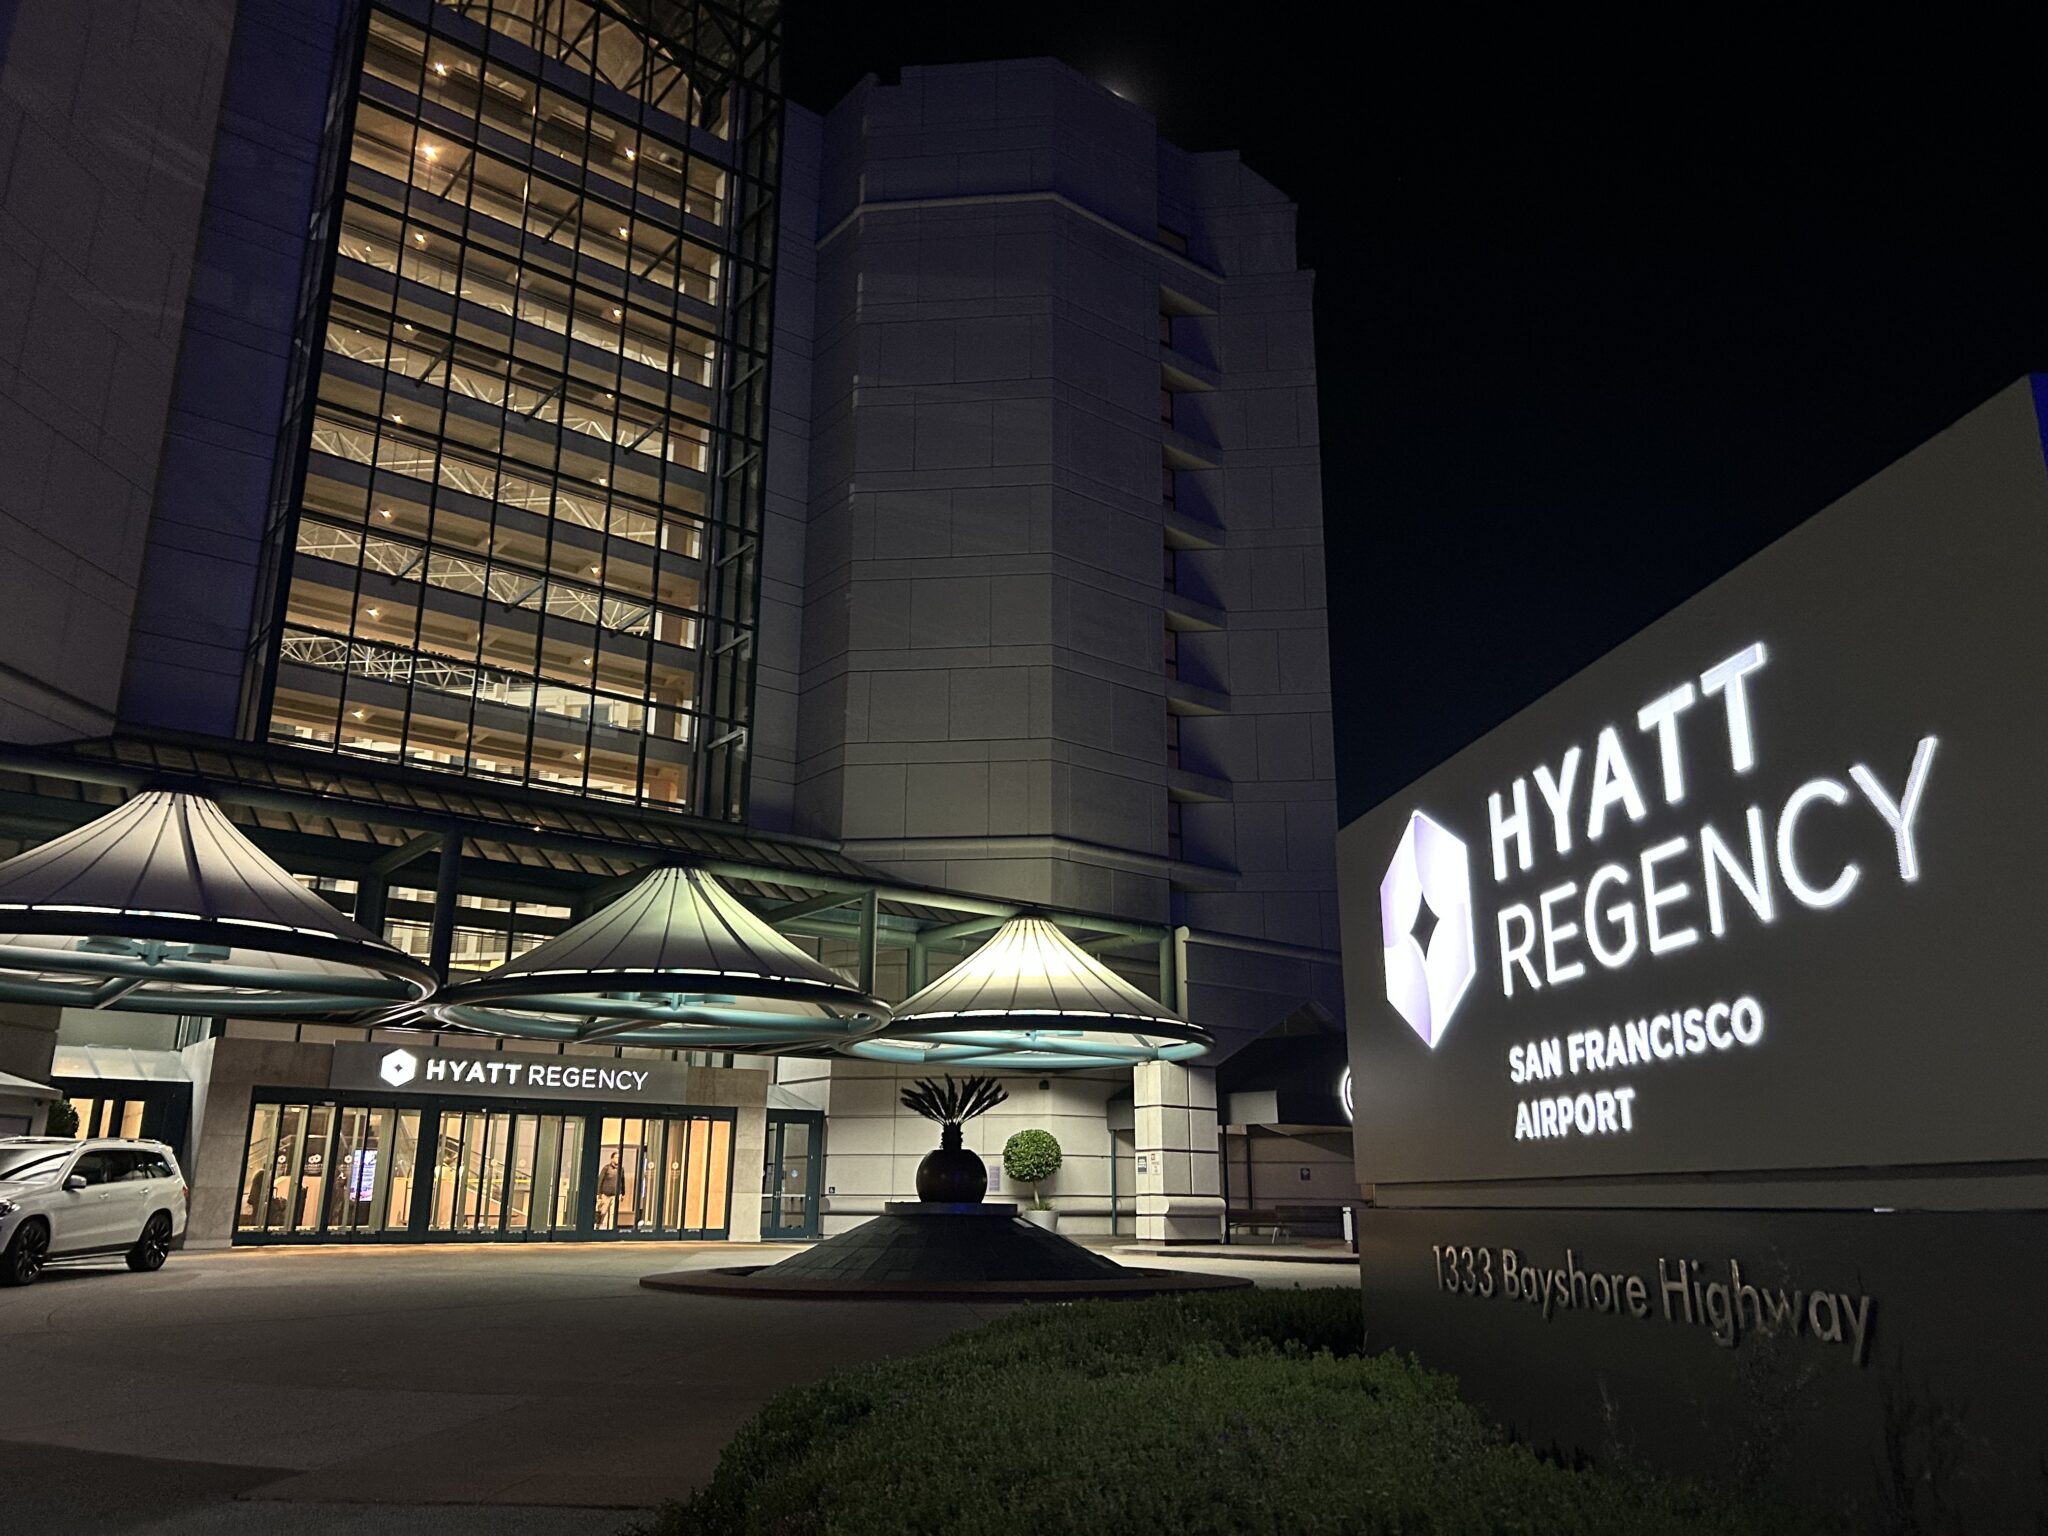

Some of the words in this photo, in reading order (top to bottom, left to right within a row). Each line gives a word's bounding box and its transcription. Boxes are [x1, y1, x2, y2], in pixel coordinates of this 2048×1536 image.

[1487, 640, 1768, 884] HYATT
[1497, 735, 1939, 998] REGENCY
[426, 1058, 523, 1084] HYATT
[528, 1064, 649, 1092] REGENCY
[1509, 1037, 1564, 1084] SAN
[1567, 996, 1766, 1075] FRANCISCO
[1514, 1086, 1636, 1141] AIRPORT
[1432, 1245, 1494, 1298] 1333
[1502, 1247, 1648, 1319] Bayshore
[1658, 1257, 1872, 1365] Highway
